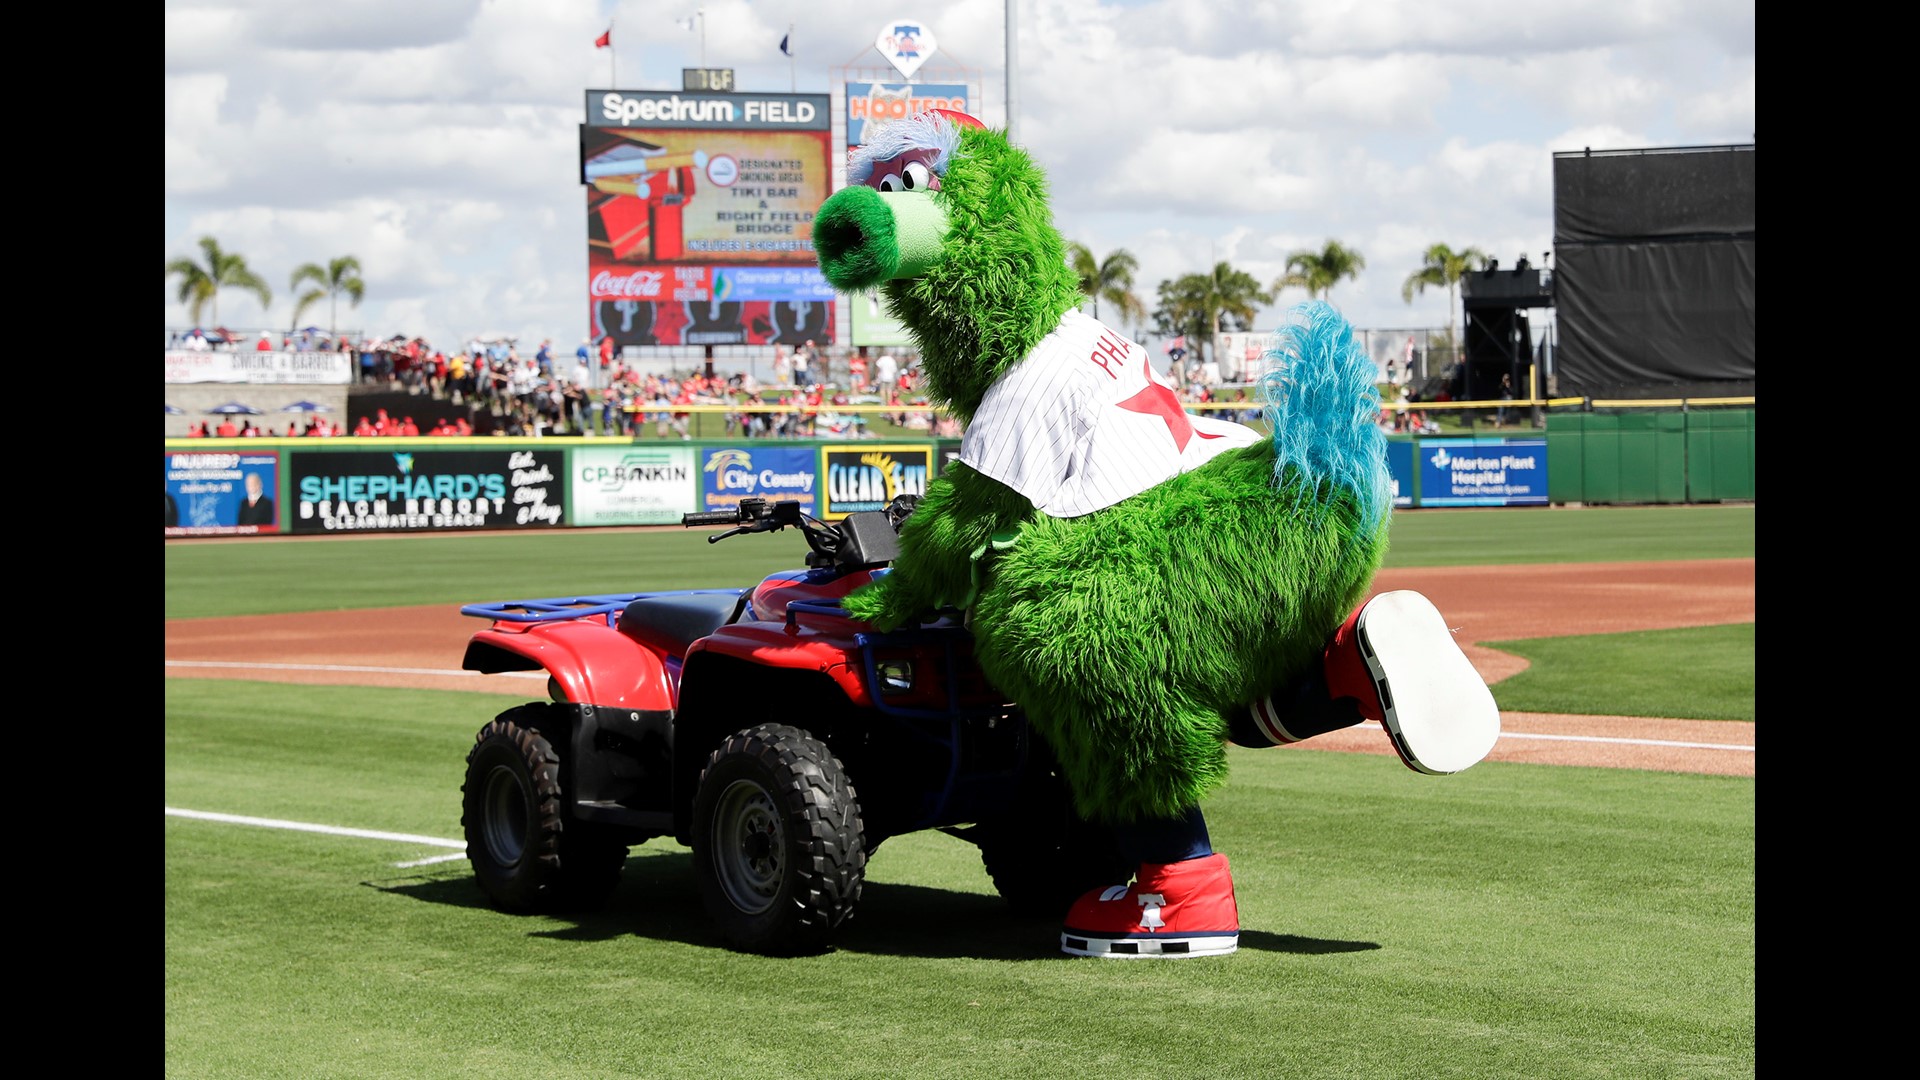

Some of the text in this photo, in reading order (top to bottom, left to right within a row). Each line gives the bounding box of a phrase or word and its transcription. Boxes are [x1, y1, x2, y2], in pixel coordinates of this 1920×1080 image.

[603, 93, 816, 126] Spectrum FIELD
[731, 188, 798, 197] TIKI BAR
[717, 213, 763, 221] RIGHT
[735, 225, 793, 234] BRIDGE
[1451, 456, 1536, 470] Morton Plant
[724, 469, 814, 492] City County
[829, 462, 926, 502] CLEAR SKY
[1451, 471, 1506, 486] Hospital
[300, 474, 506, 502] SHEPHARD'S
[300, 497, 505, 519] BEACH RESORT
[324, 513, 485, 529] CLEARWATER BEACH
